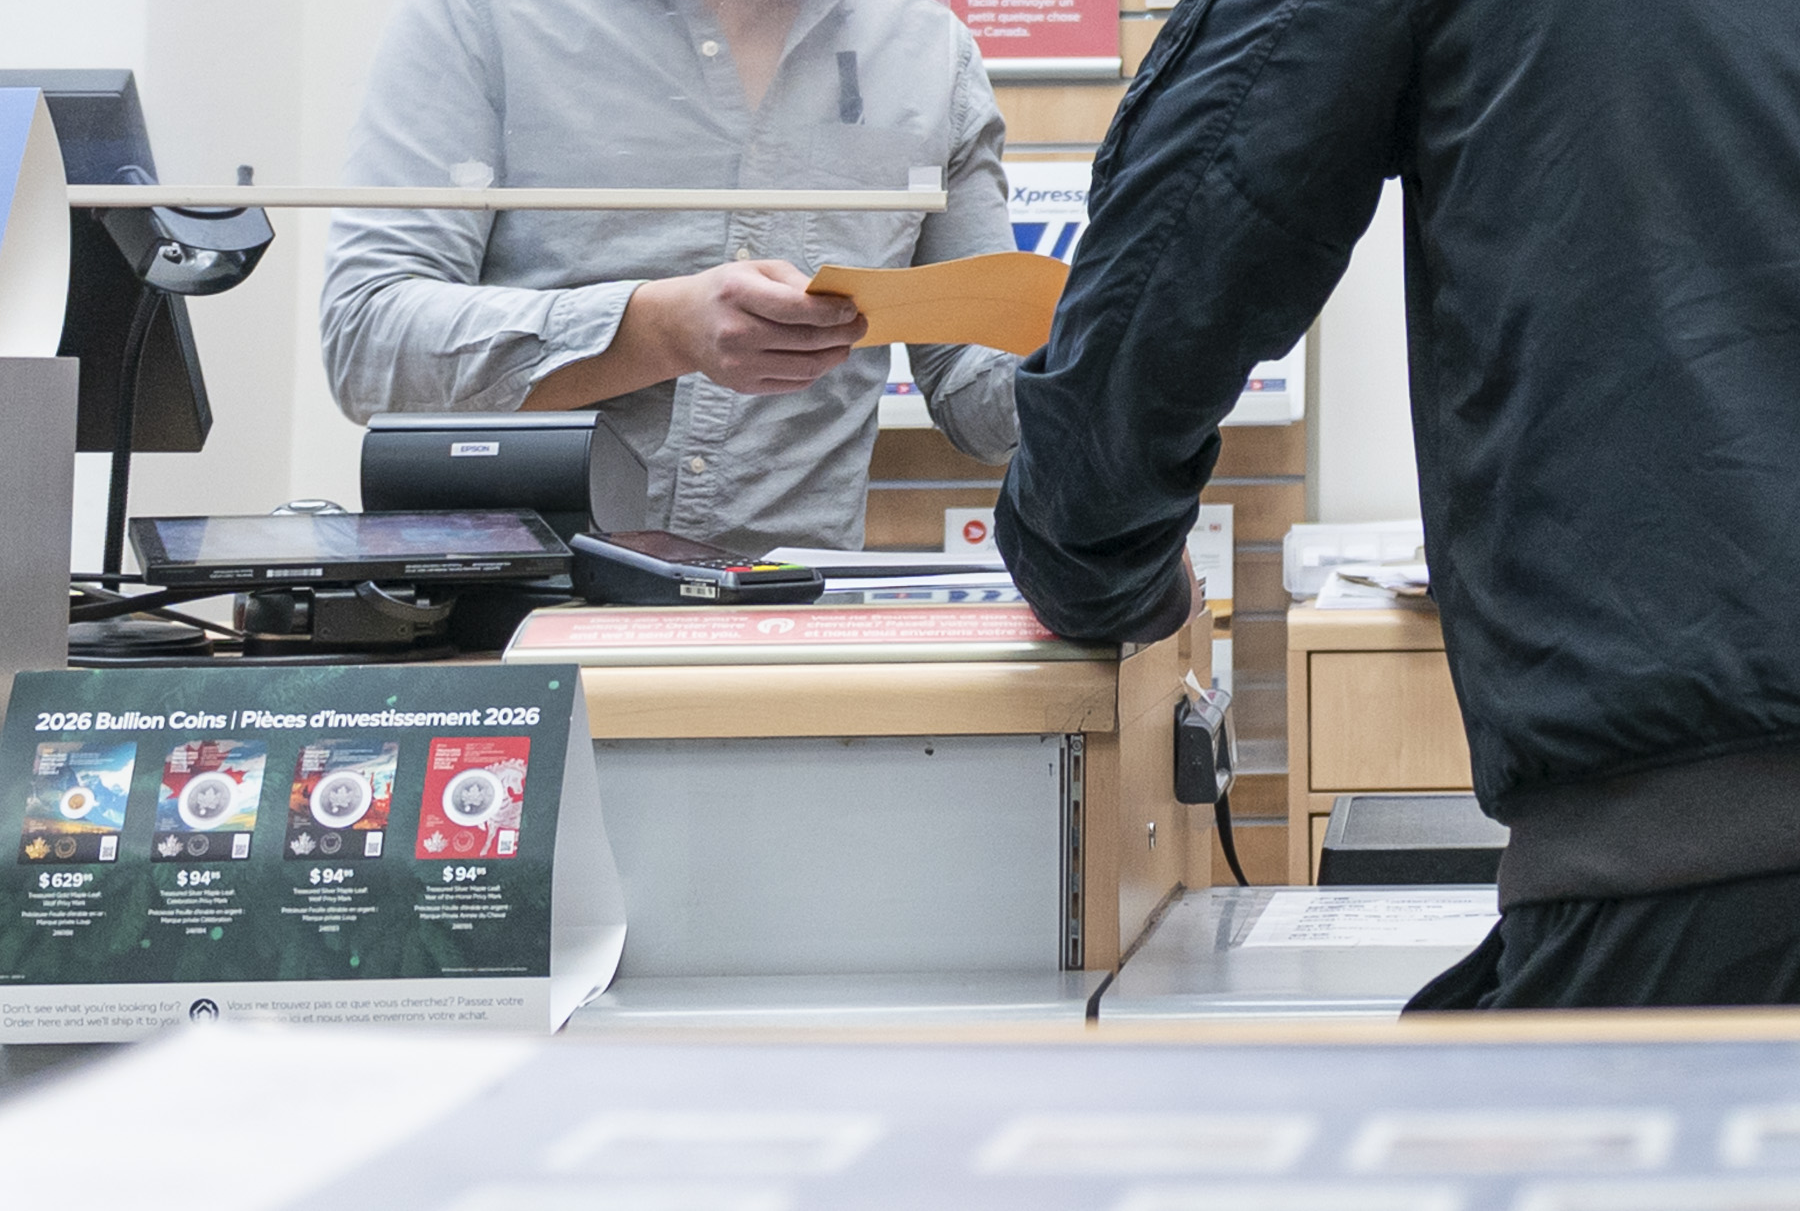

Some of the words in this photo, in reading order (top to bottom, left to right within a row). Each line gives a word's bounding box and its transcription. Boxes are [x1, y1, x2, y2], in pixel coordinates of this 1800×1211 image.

[35, 712, 92, 731] 2026
[95, 711, 166, 731] Bullion
[168, 710, 227, 729] Coins
[240, 709, 307, 729] Pièces
[309, 709, 481, 728] d'investissement
[483, 707, 540, 726] 2026
[2, 1003, 32, 1014] Don't
[35, 1004, 53, 1014] see
[55, 1003, 81, 1014] what
[84, 1002, 116, 1015] you're
[118, 1002, 157, 1016] looking
[159, 1001, 182, 1012] for?
[255, 1002, 269, 1011] ne
[314, 1001, 333, 1012] pas
[335, 1001, 348, 1010] ce
[350, 1000, 370, 1012] que
[373, 999, 398, 1009] vous
[401, 996, 454, 1008] cherchez?
[457, 997, 493, 1008] Passez
[496, 996, 524, 1007] votre
[3, 1017, 35, 1028] Order
[37, 1017, 61, 1028] here
[64, 1016, 84, 1028] and
[87, 1016, 109, 1028] we'll
[111, 1015, 134, 1029] ship
[136, 1016, 144, 1027] it
[146, 1017, 157, 1027] to
[316, 1013, 342, 1023] nous
[345, 1012, 371, 1023] vous
[372, 1012, 425, 1023] enverrons
[428, 1010, 455, 1021] votre
[458, 1010, 488, 1021] achat.
